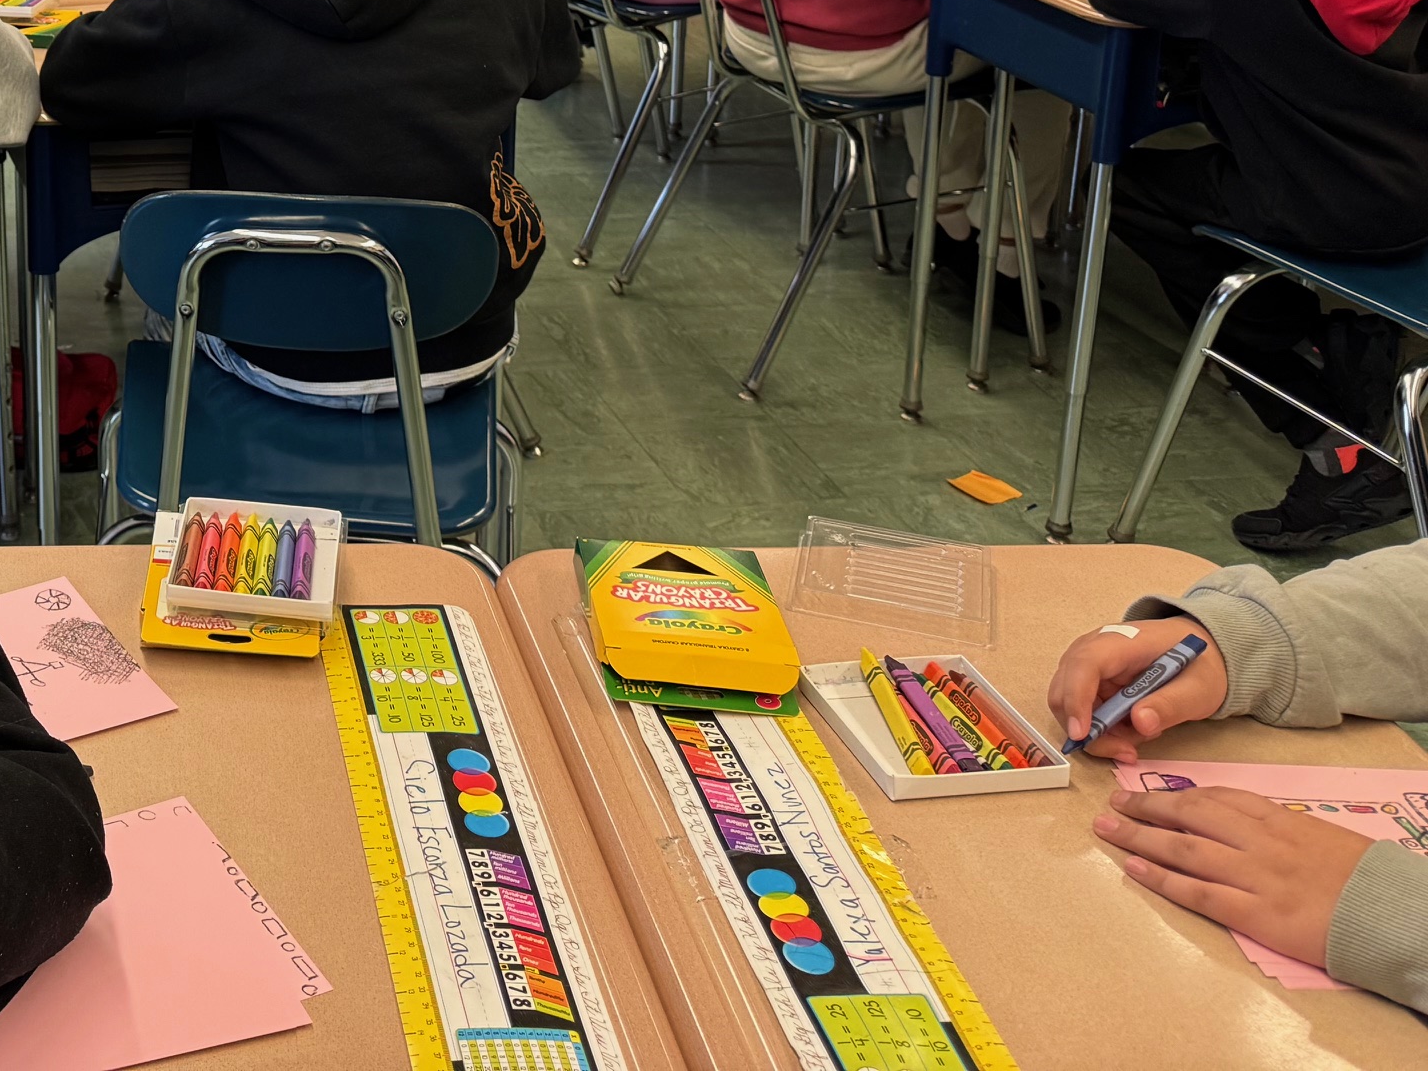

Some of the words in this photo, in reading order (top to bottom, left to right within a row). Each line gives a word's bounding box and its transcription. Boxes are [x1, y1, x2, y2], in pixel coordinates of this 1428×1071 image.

[615, 586, 755, 611] TRIANGULAR
[633, 580, 727, 600] CRAYONS
[163, 616, 235, 630] TRIANGULAR
[648, 619, 743, 635] Crayola
[616, 684, 662, 697] Anti-
[1124, 666, 1162, 696] Crayola
[953, 693, 979, 723] Crayola
[952, 717, 980, 747] Crayola
[799, 830, 850, 889] Santos
[405, 759, 444, 815] Cielo
[440, 904, 489, 989] Lozada
[509, 915, 541, 927] Thousands
[515, 933, 545, 945] Hundreds
[523, 957, 539, 965] Ones
